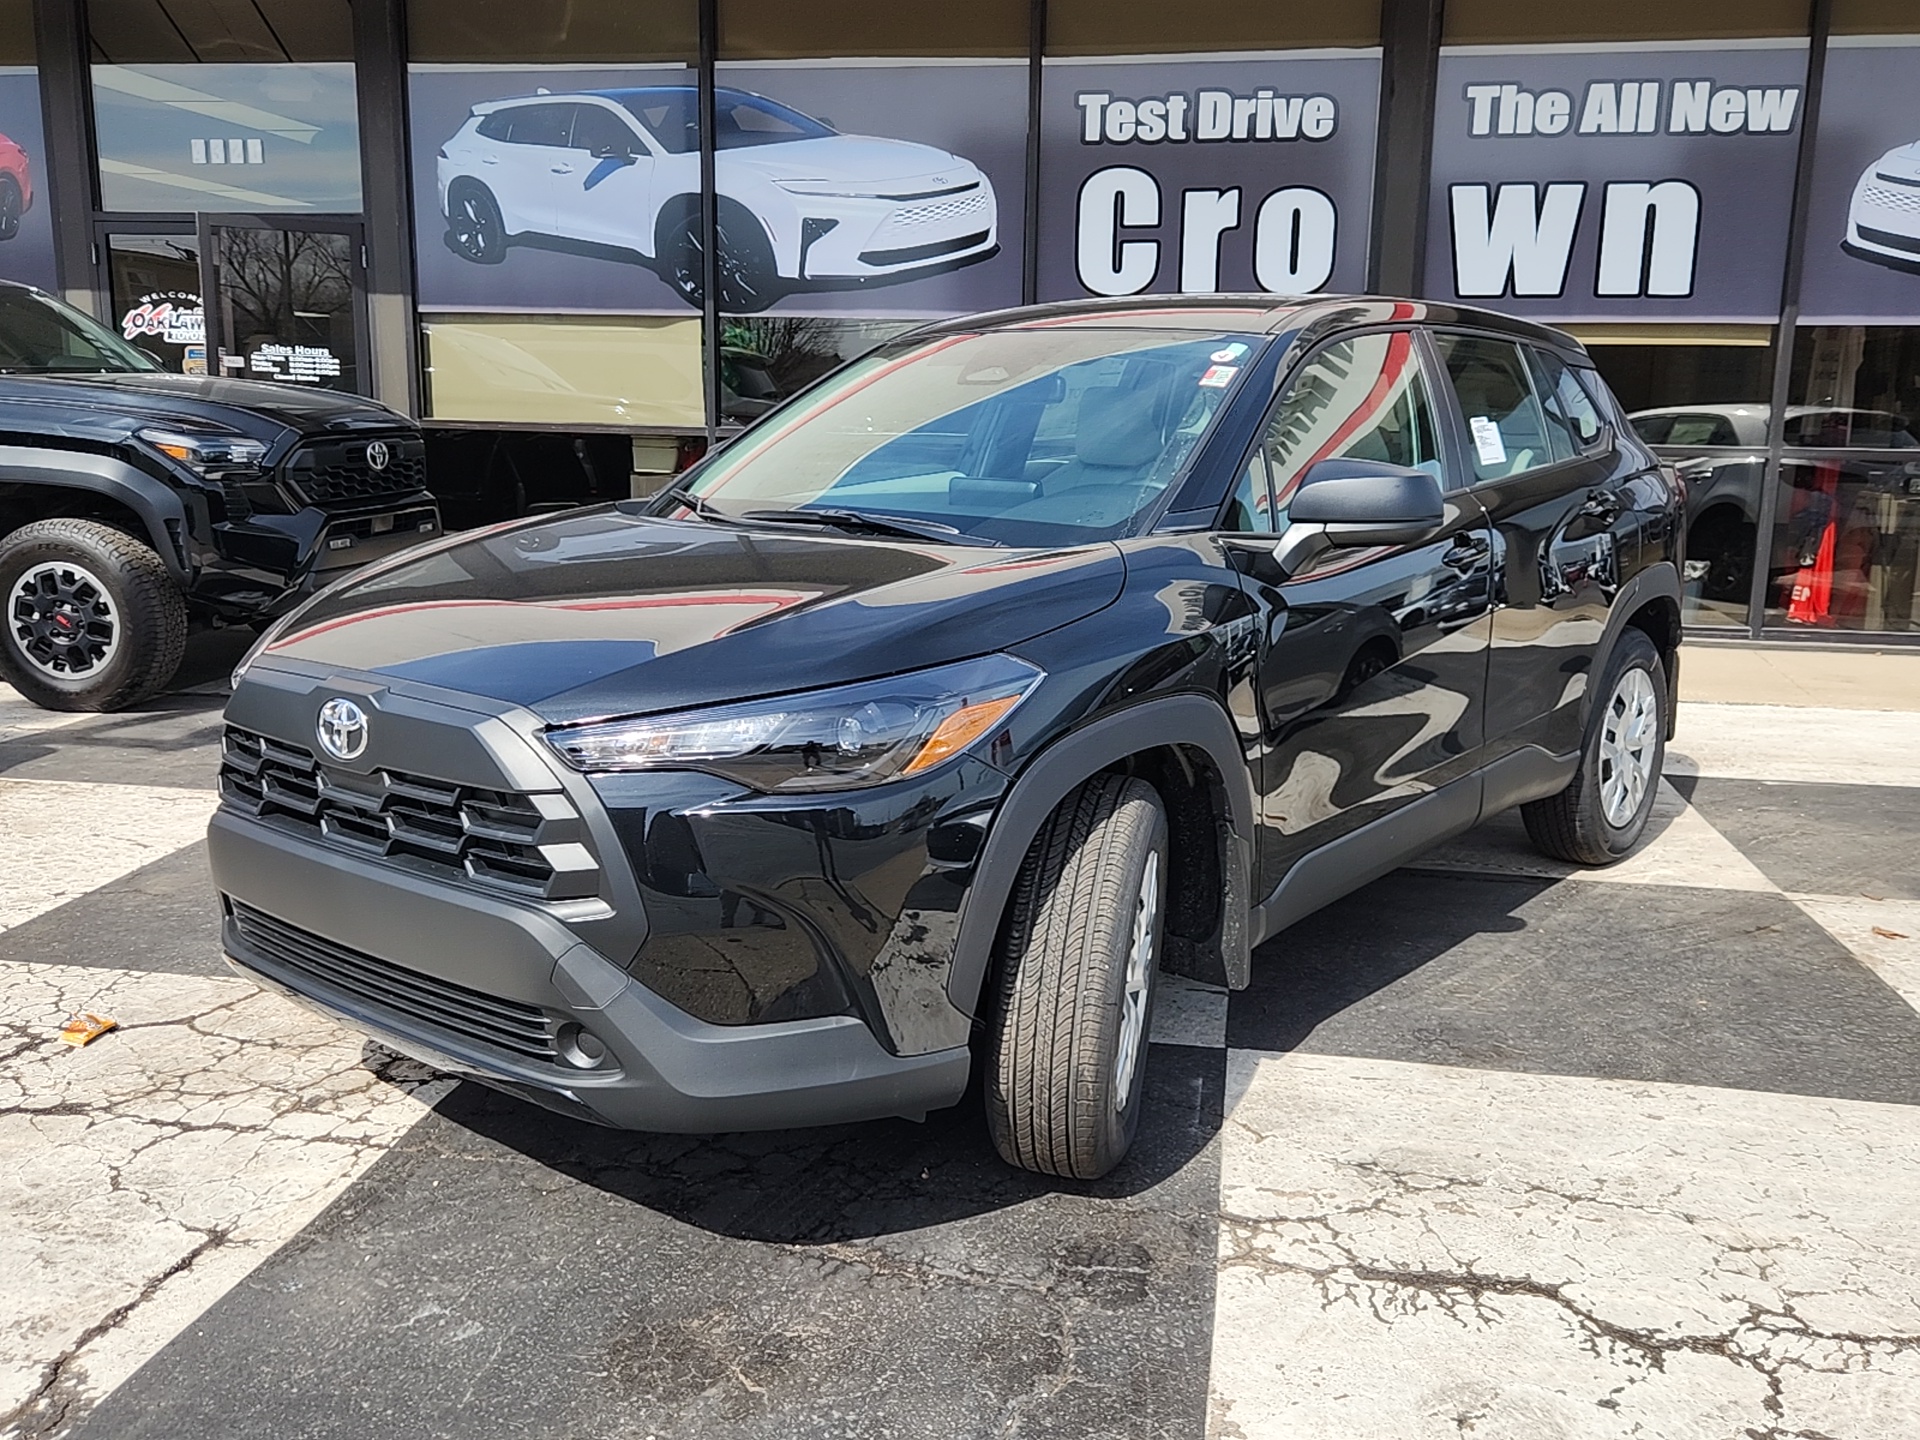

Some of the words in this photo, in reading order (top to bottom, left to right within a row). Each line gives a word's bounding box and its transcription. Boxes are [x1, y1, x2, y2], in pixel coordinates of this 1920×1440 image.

[1078, 93, 1188, 142] Test
[1197, 87, 1336, 141] Drive
[1466, 84, 1571, 136] The
[1579, 81, 1661, 135] All
[1668, 80, 1800, 133] New
[261, 344, 293, 355] Sales
[295, 346, 329, 357] Hours
